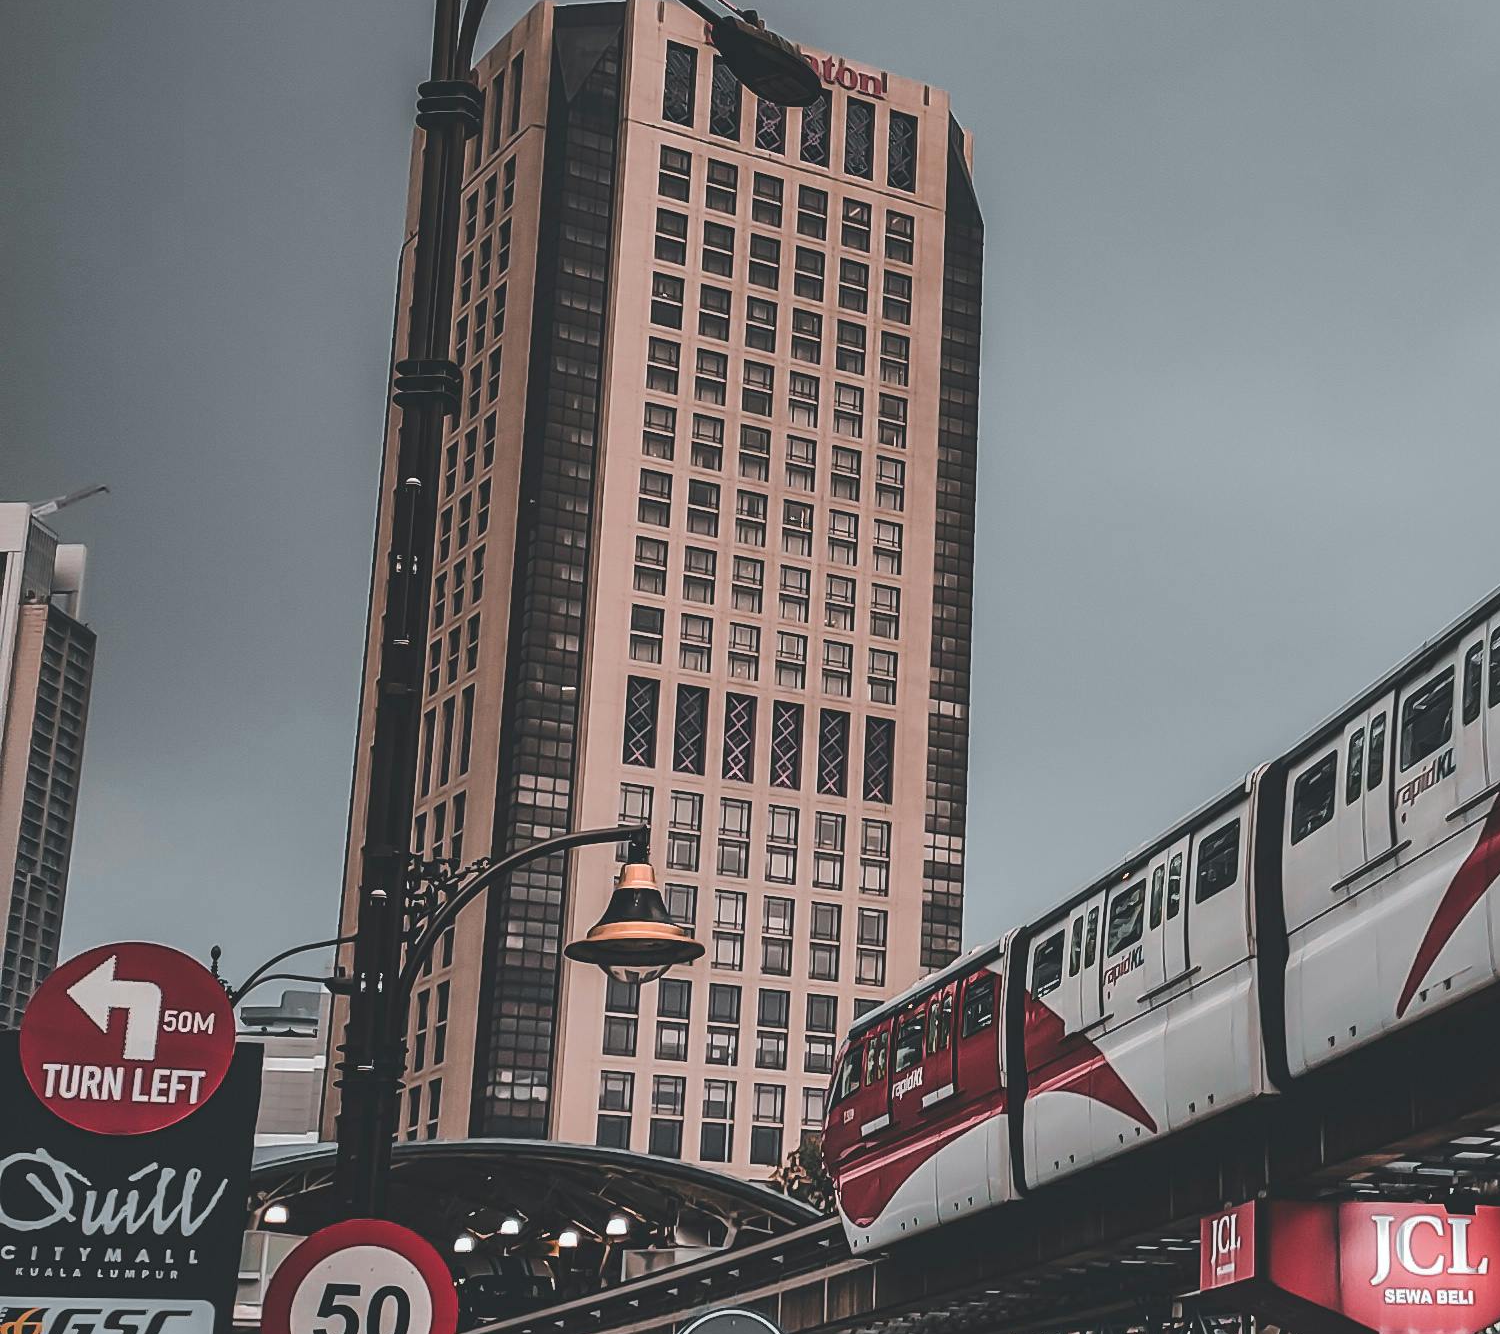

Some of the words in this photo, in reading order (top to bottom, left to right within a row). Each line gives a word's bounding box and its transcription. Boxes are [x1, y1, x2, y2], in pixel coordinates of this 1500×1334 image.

[162, 1010, 215, 1035] 50M
[42, 1063, 124, 1101] TURN
[131, 1067, 207, 1105] LEFT
[0, 1147, 229, 1237] Quill
[1210, 1214, 1241, 1266] JCL
[1369, 1214, 1490, 1286] JCL
[15, 1267, 82, 1279] KUALA
[97, 1268, 179, 1280] LUMPUR
[1384, 1288, 1433, 1305] SEWA
[1436, 1288, 1475, 1306] BELI
